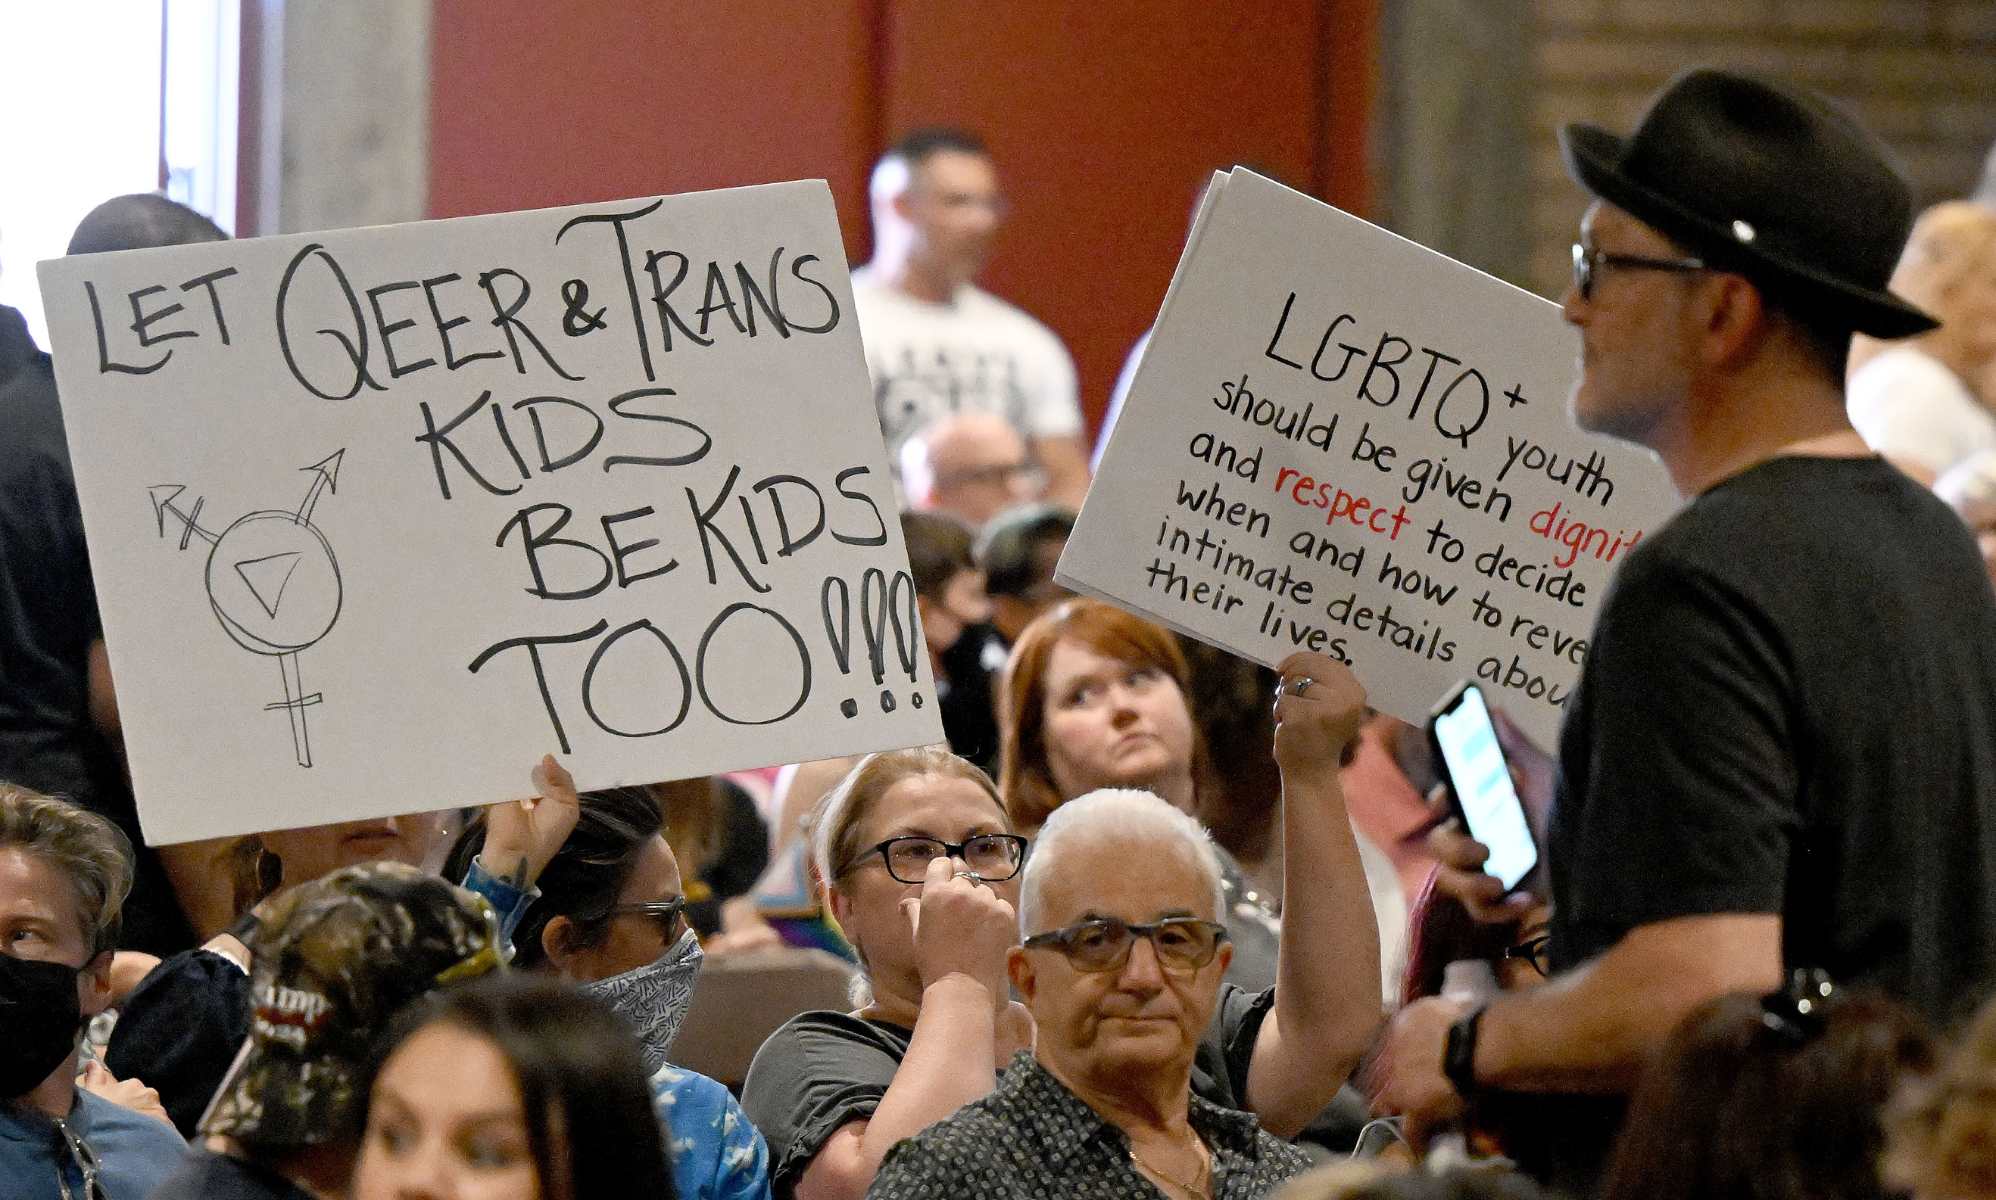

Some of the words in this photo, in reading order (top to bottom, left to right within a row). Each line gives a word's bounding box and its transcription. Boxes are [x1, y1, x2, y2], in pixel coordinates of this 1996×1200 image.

[84, 266, 237, 375] LET
[276, 244, 585, 400] QEER
[556, 200, 840, 382] TRANS
[562, 279, 608, 336] &
[415, 388, 712, 499] KIDS
[1213, 374, 1339, 452] should
[1351, 422, 1397, 472] be
[1402, 456, 1512, 522] given
[1265, 292, 1528, 449] LGBTQ+
[1496, 436, 1614, 507] youth
[497, 502, 678, 600] BE
[686, 465, 887, 592] KIDS
[1157, 515, 1313, 604] intimate
[1326, 593, 1457, 662] details
[1176, 480, 1270, 537] when
[1290, 531, 1365, 577] and
[1378, 552, 1458, 606] how
[1472, 590, 1502, 627] to
[1510, 615, 1589, 665] reve
[1190, 432, 1263, 483] and
[1274, 467, 1411, 540] respect
[1427, 519, 1464, 562] to
[1475, 544, 1586, 607] decide
[1146, 558, 1243, 614] their
[1260, 601, 1352, 666] lives.
